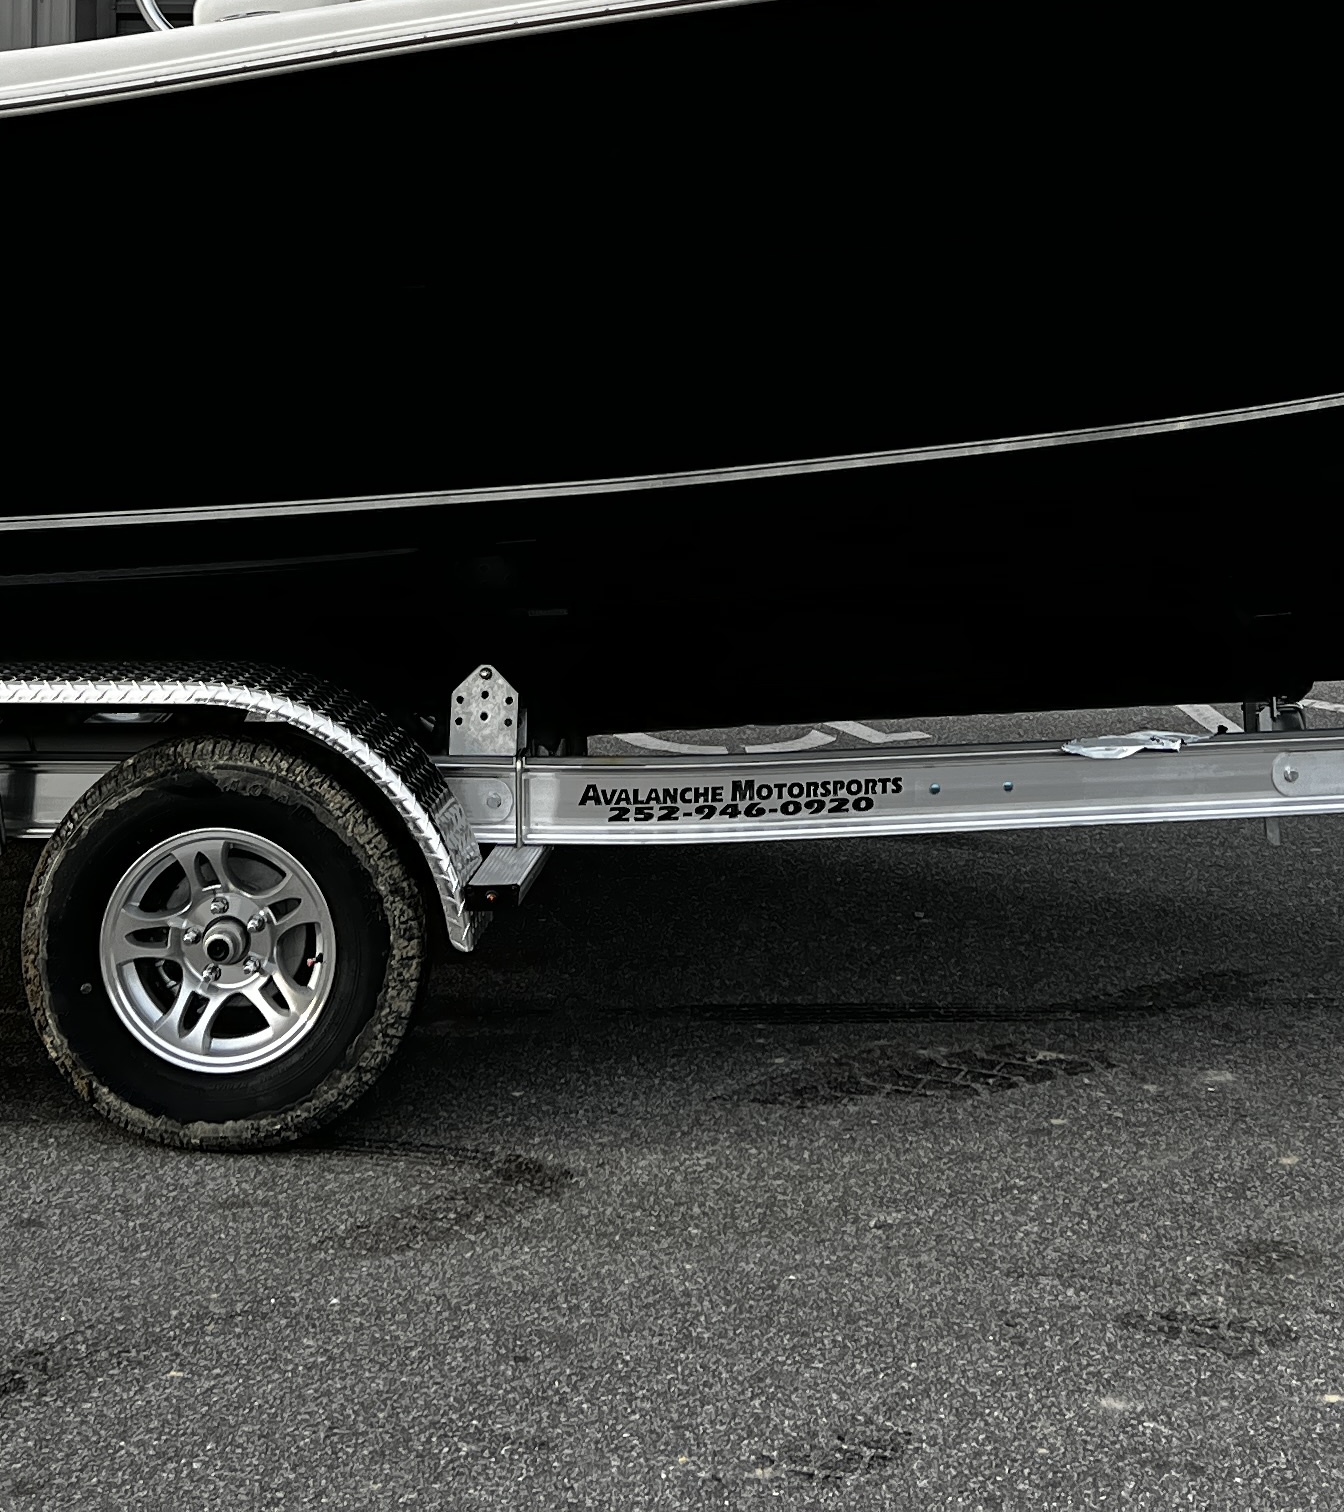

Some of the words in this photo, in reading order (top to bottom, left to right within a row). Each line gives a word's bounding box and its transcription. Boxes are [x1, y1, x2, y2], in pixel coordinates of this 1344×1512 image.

[579, 783, 723, 806] AVALANCHE
[731, 776, 903, 802] MOTORSPORTS
[608, 796, 874, 822] 252-946-0920
